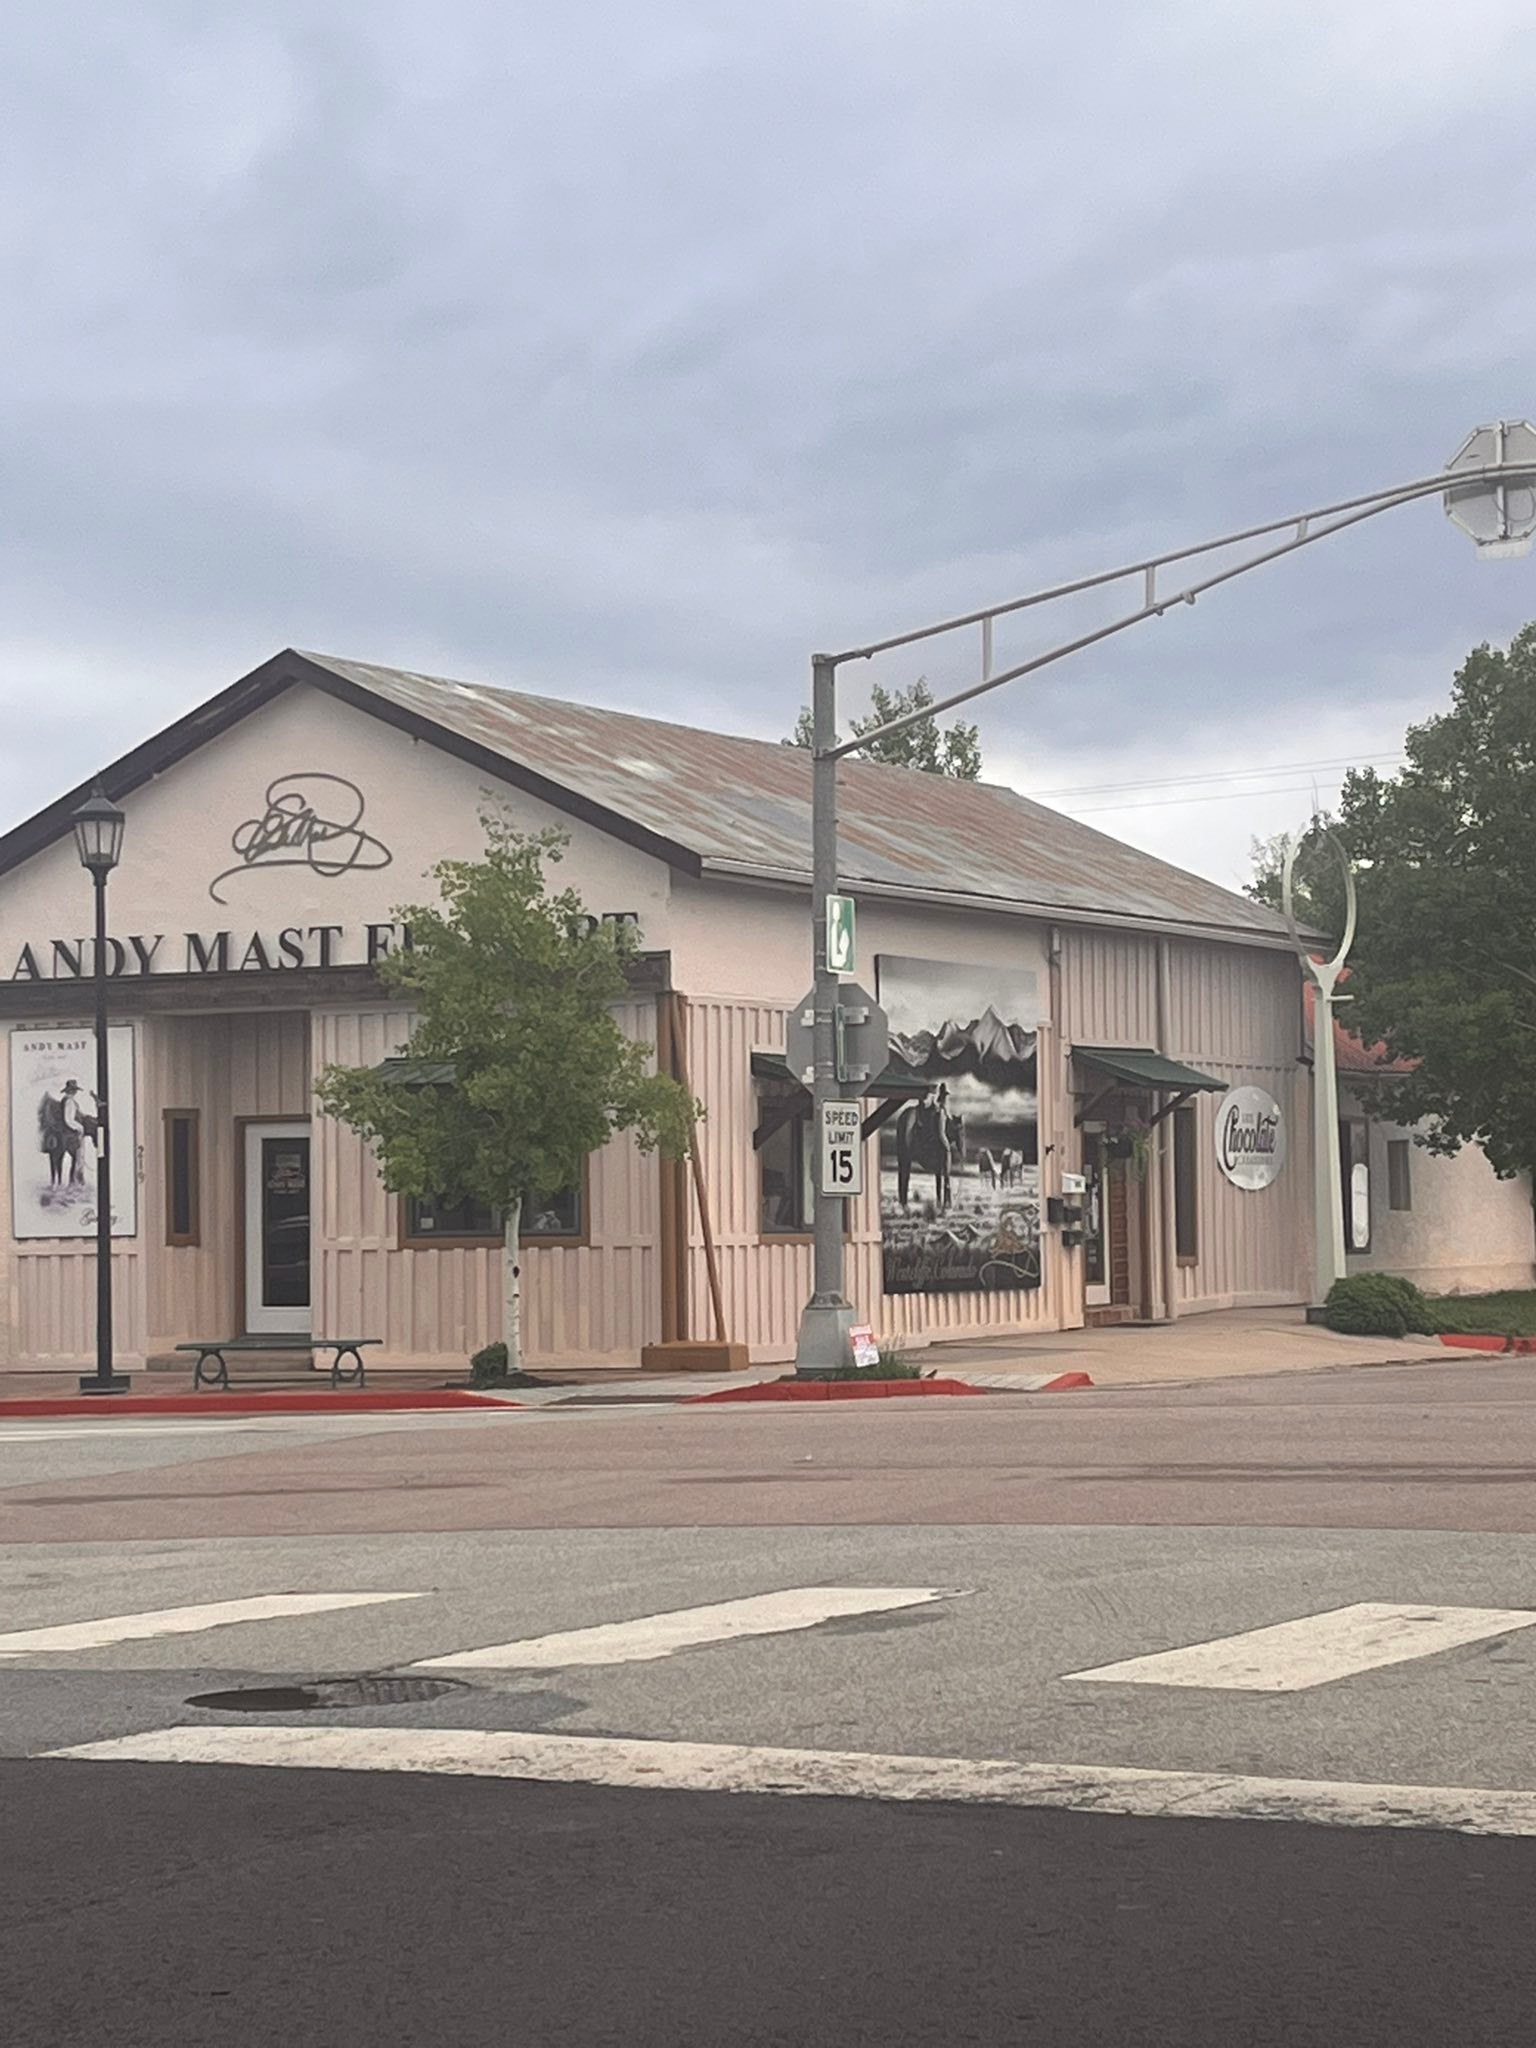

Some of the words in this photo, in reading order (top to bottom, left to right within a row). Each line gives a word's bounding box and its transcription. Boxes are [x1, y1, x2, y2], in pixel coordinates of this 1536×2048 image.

[12, 934, 164, 981] ANDY
[184, 925, 344, 973] MAST
[825, 1111, 859, 1126] SPEED
[828, 1131, 855, 1145] LIMIT
[1223, 1104, 1279, 1171] Chocolate
[831, 1150, 853, 1184] 15
